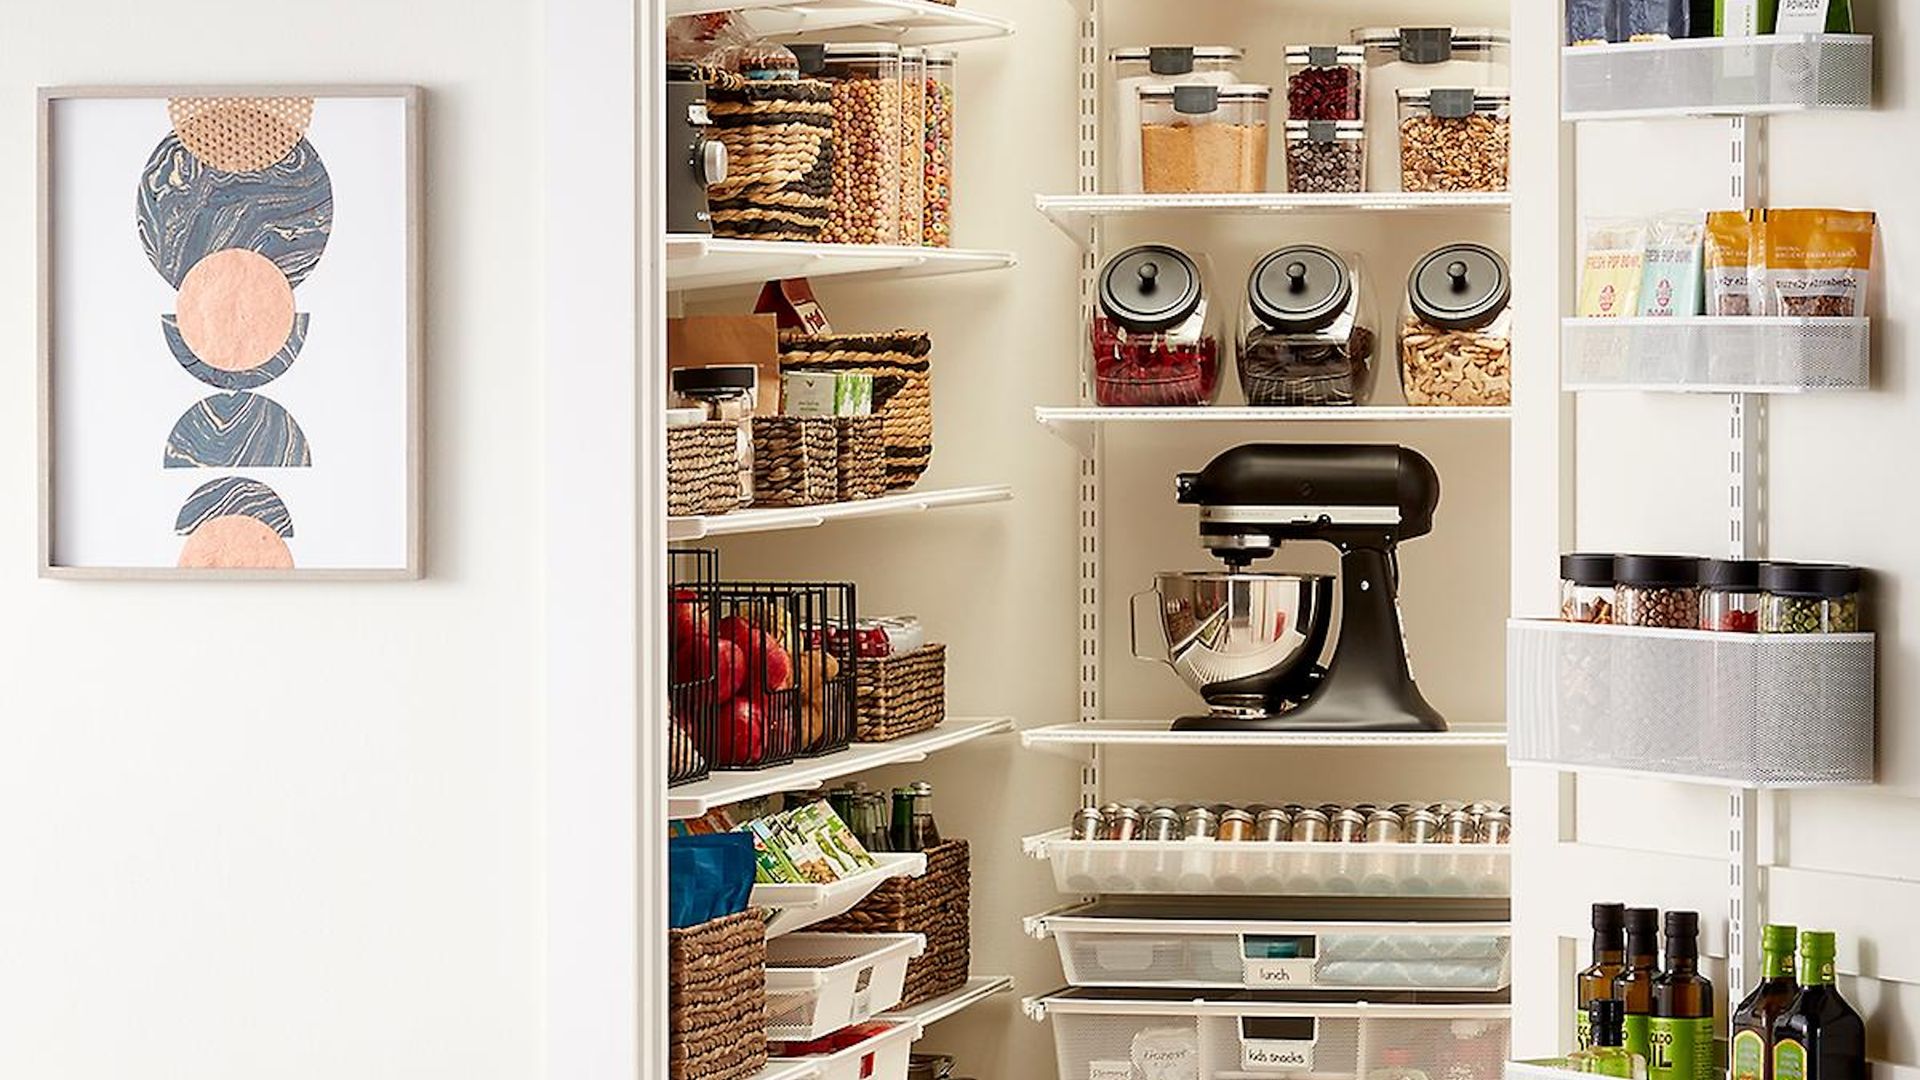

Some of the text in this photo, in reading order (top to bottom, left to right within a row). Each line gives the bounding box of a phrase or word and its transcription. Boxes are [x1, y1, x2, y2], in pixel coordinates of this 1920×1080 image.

[1259, 968, 1290, 981] lunch
[1248, 1049, 1305, 1064] kids snacks
